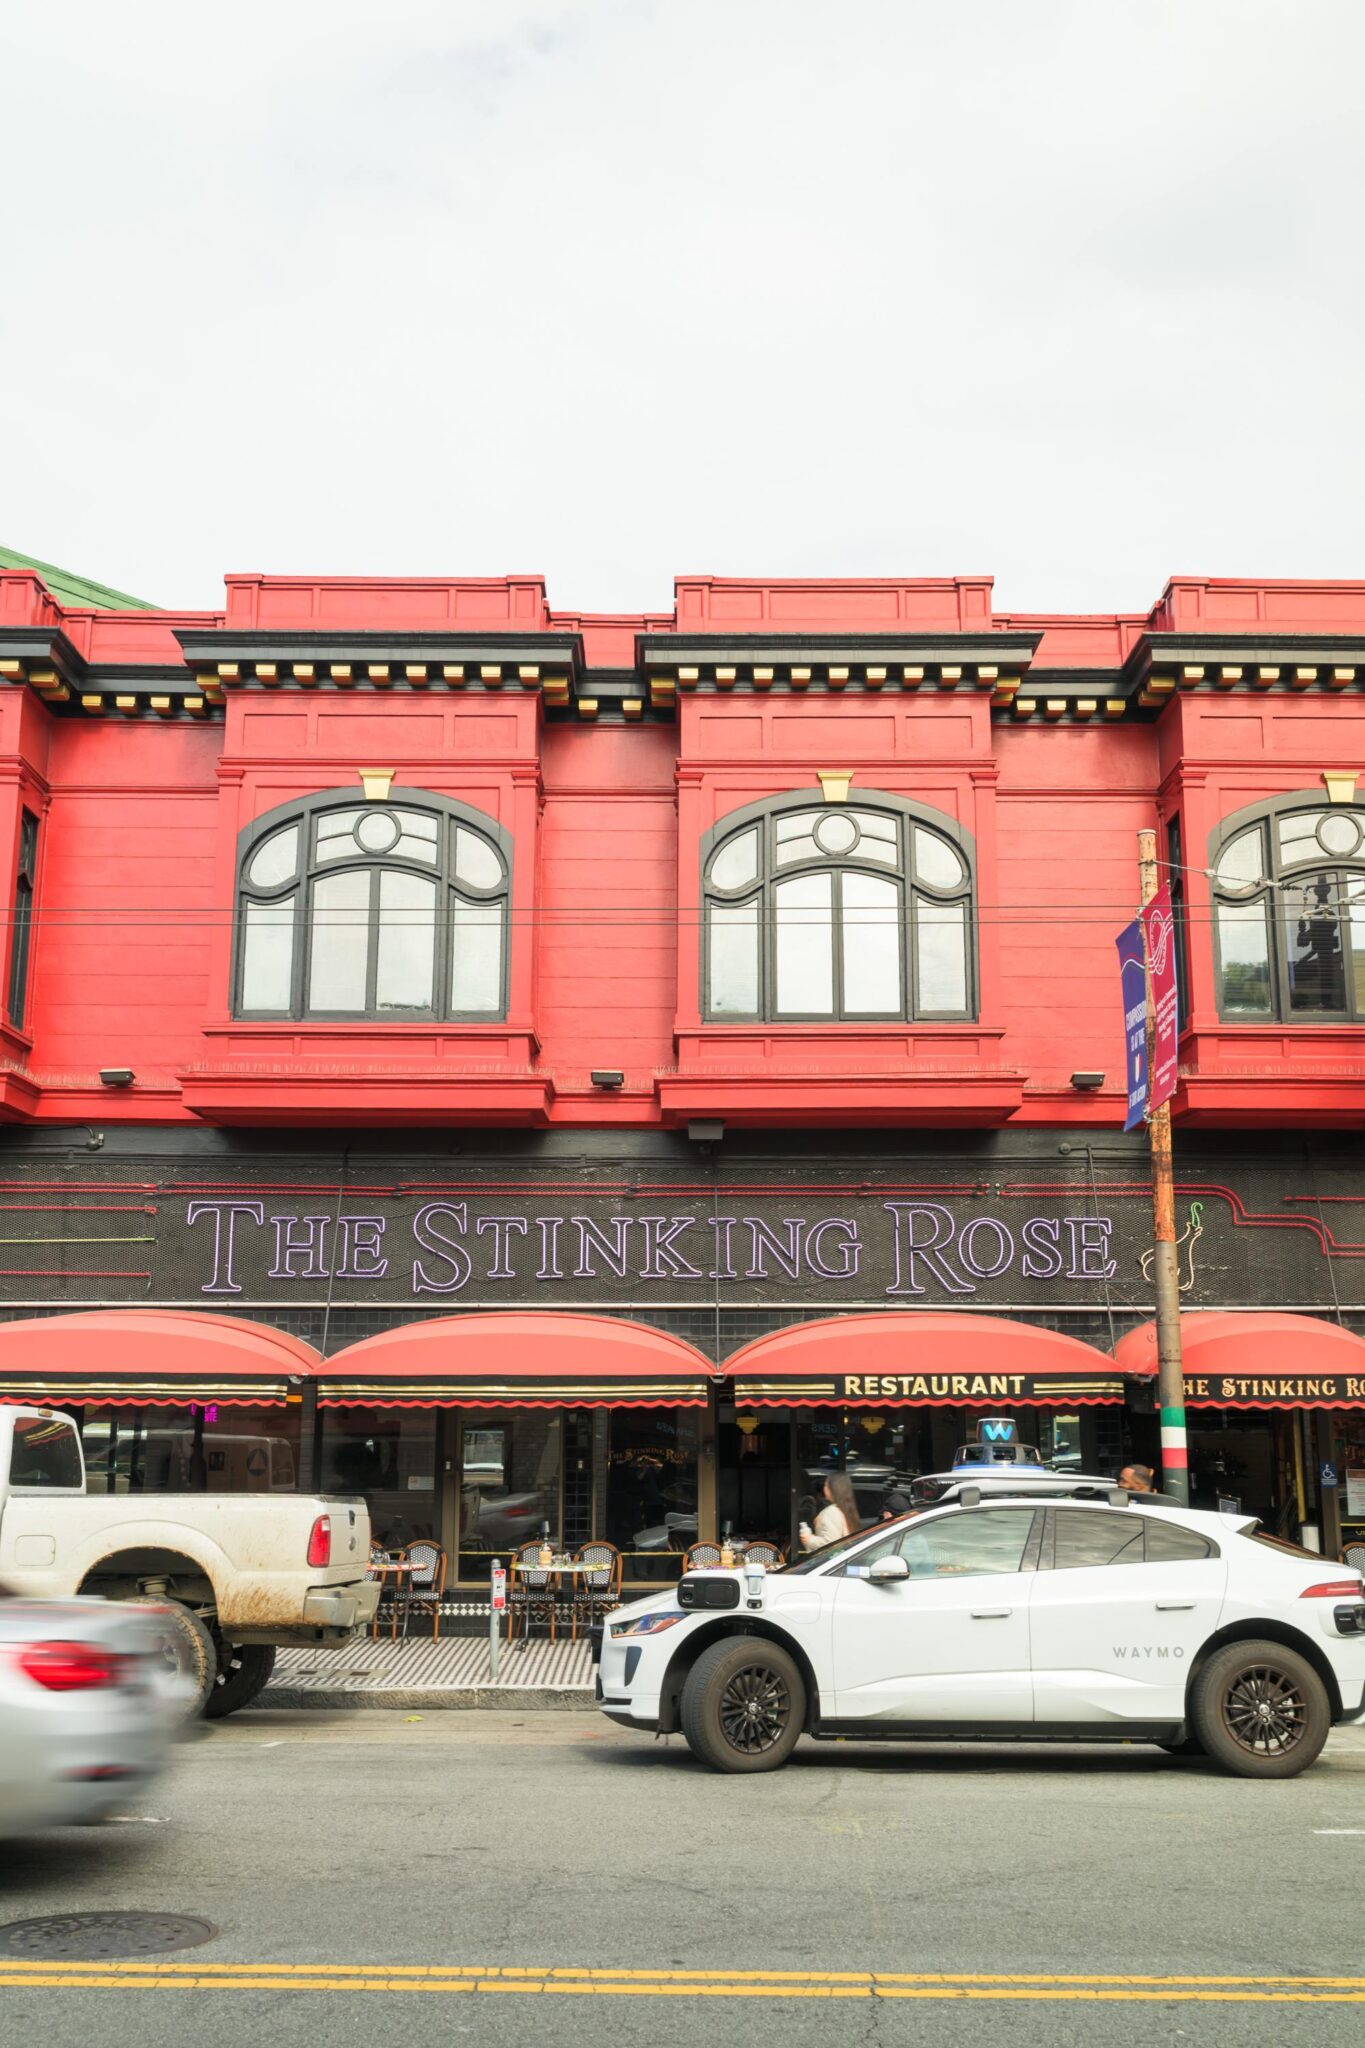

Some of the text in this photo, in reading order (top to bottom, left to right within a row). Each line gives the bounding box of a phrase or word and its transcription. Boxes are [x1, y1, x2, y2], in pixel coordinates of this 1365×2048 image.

[187, 1201, 1117, 1294] THE STINKING ROSE
[844, 1375, 1026, 1396] RESTAURANT
[1182, 1379, 1210, 1396] HE
[1221, 1378, 1337, 1398] STINKING
[1112, 1646, 1185, 1659] WAYMO
